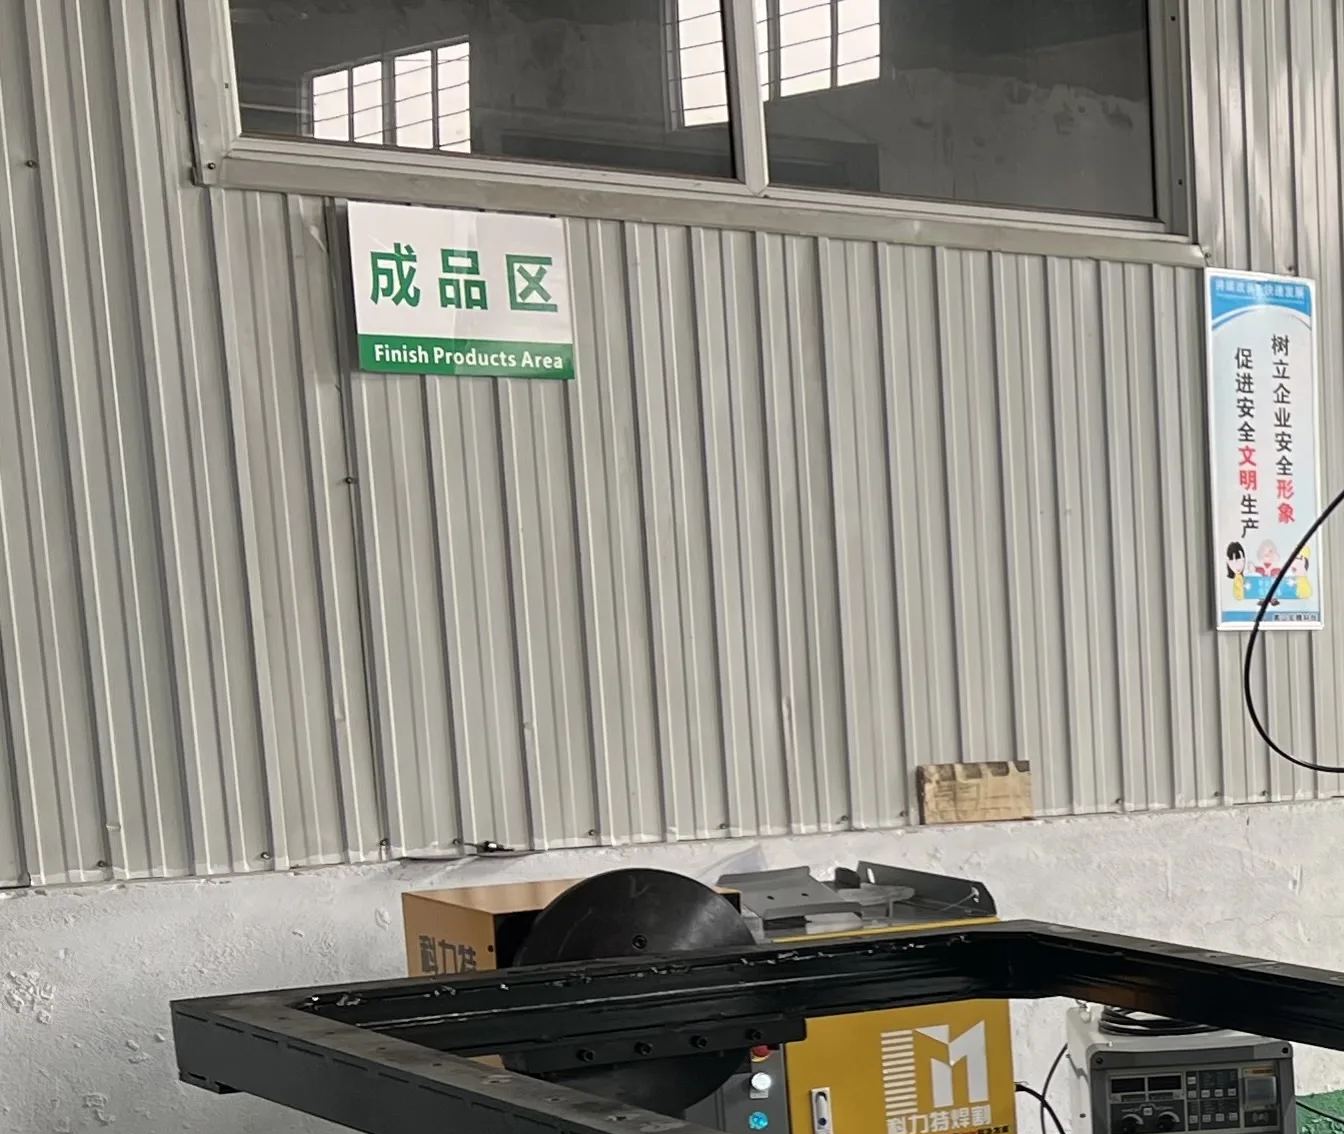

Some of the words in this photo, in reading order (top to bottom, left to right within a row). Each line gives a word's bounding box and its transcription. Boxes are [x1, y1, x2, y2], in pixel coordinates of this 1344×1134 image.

[369, 242, 558, 312] 成品区
[374, 343, 429, 366] Finish
[433, 347, 517, 369] Products
[521, 350, 564, 370] Area
[1234, 347, 1259, 539] 促进安全文明生产
[1271, 334, 1295, 524] 树立企业安全形象
